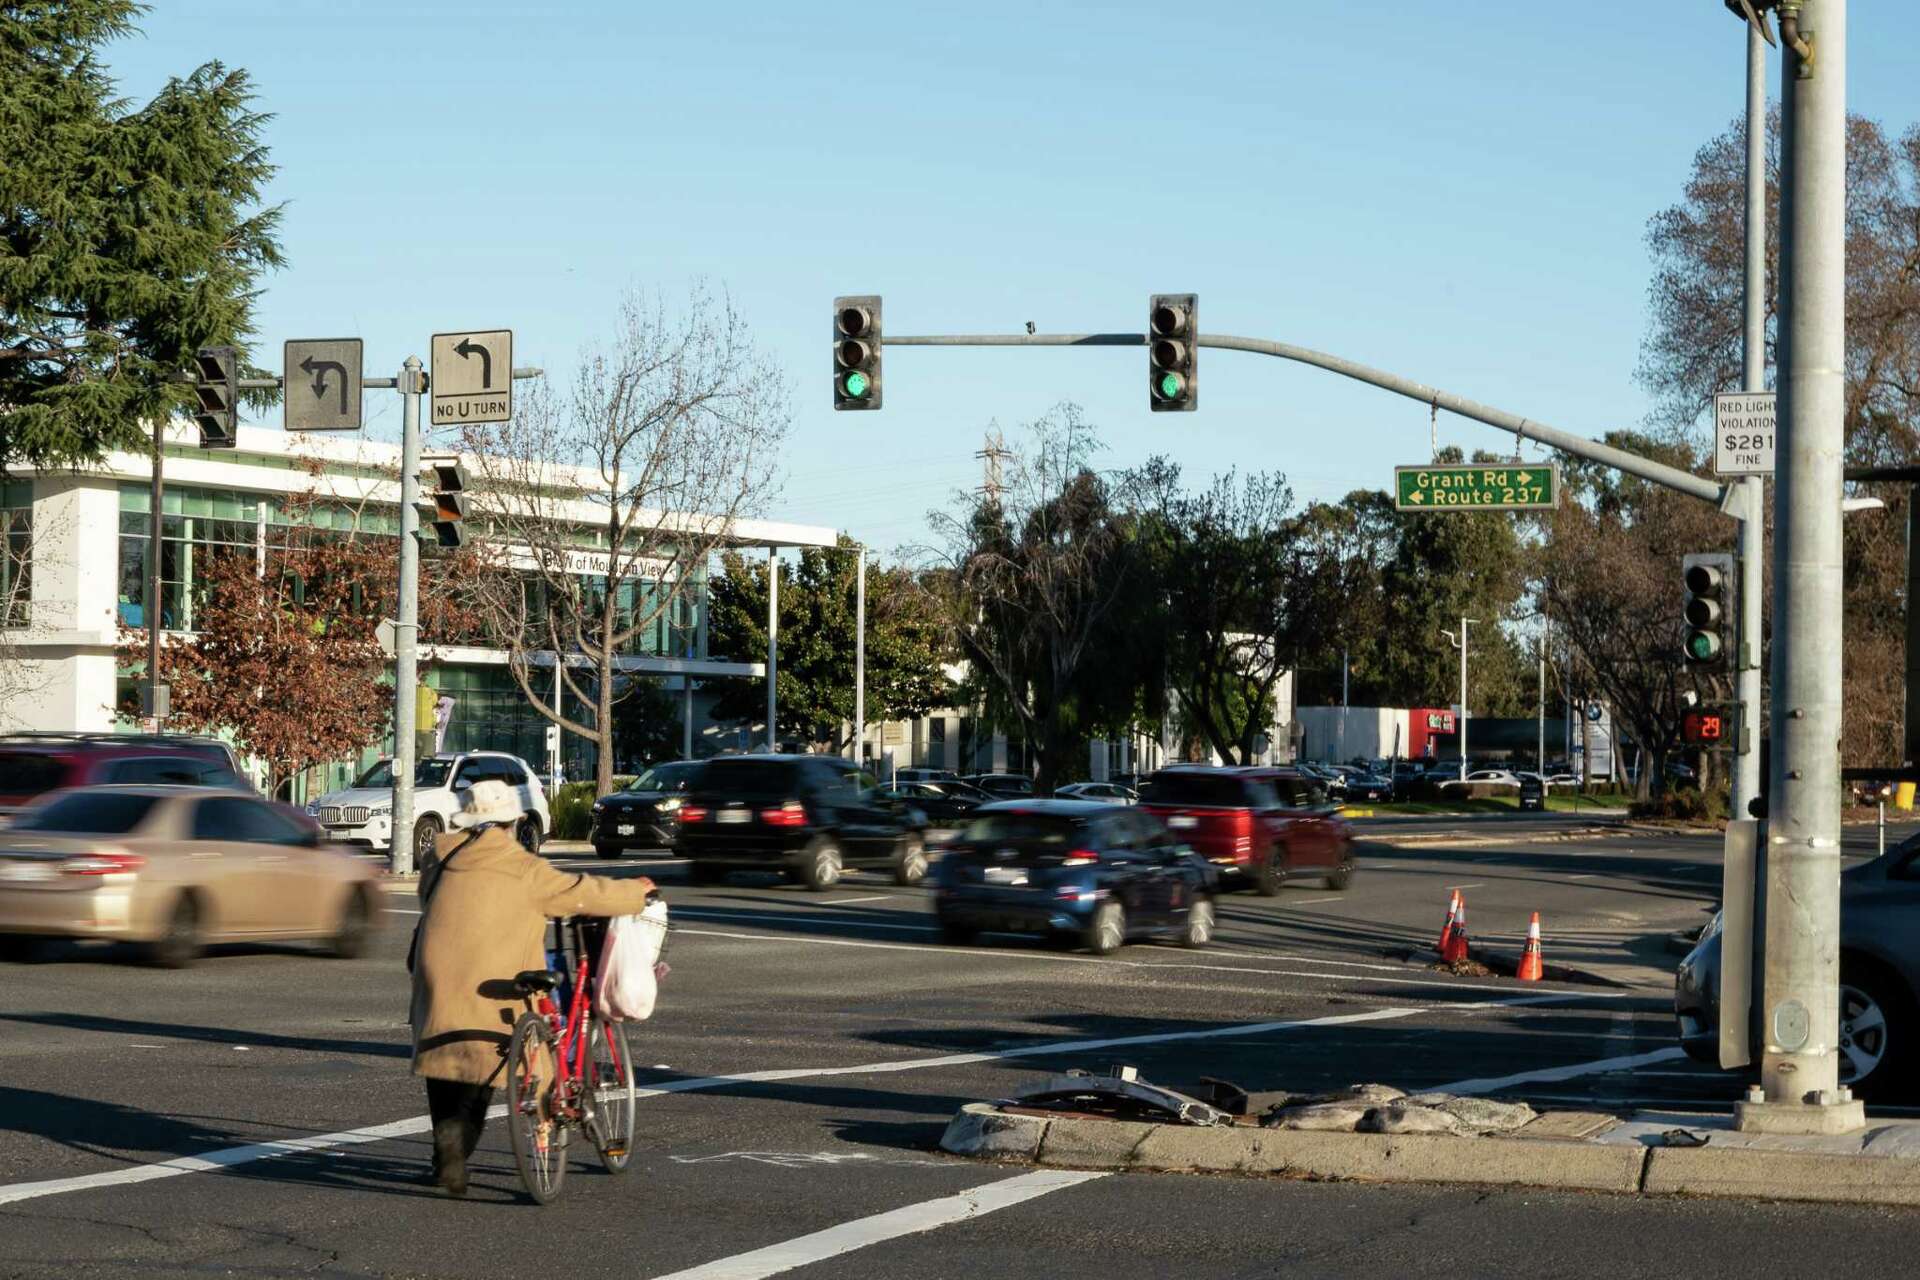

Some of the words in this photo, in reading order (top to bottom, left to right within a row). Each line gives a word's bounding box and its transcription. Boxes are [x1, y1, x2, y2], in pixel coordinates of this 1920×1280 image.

[437, 405, 454, 417] NO
[458, 401, 470, 418] U
[473, 401, 506, 415] TURN
[1719, 401, 1742, 413] RED
[1720, 417, 1777, 429] VIOLATION
[1725, 433, 1773, 451] $281
[1735, 453, 1761, 465] FINE
[1416, 471, 1474, 488] Grant
[1483, 471, 1508, 487] Rd
[1433, 488, 1493, 504] Route
[1502, 486, 1543, 503] 237
[576, 556, 587, 570] of
[590, 556, 638, 576] Moutin
[1702, 716, 1720, 737] 29
